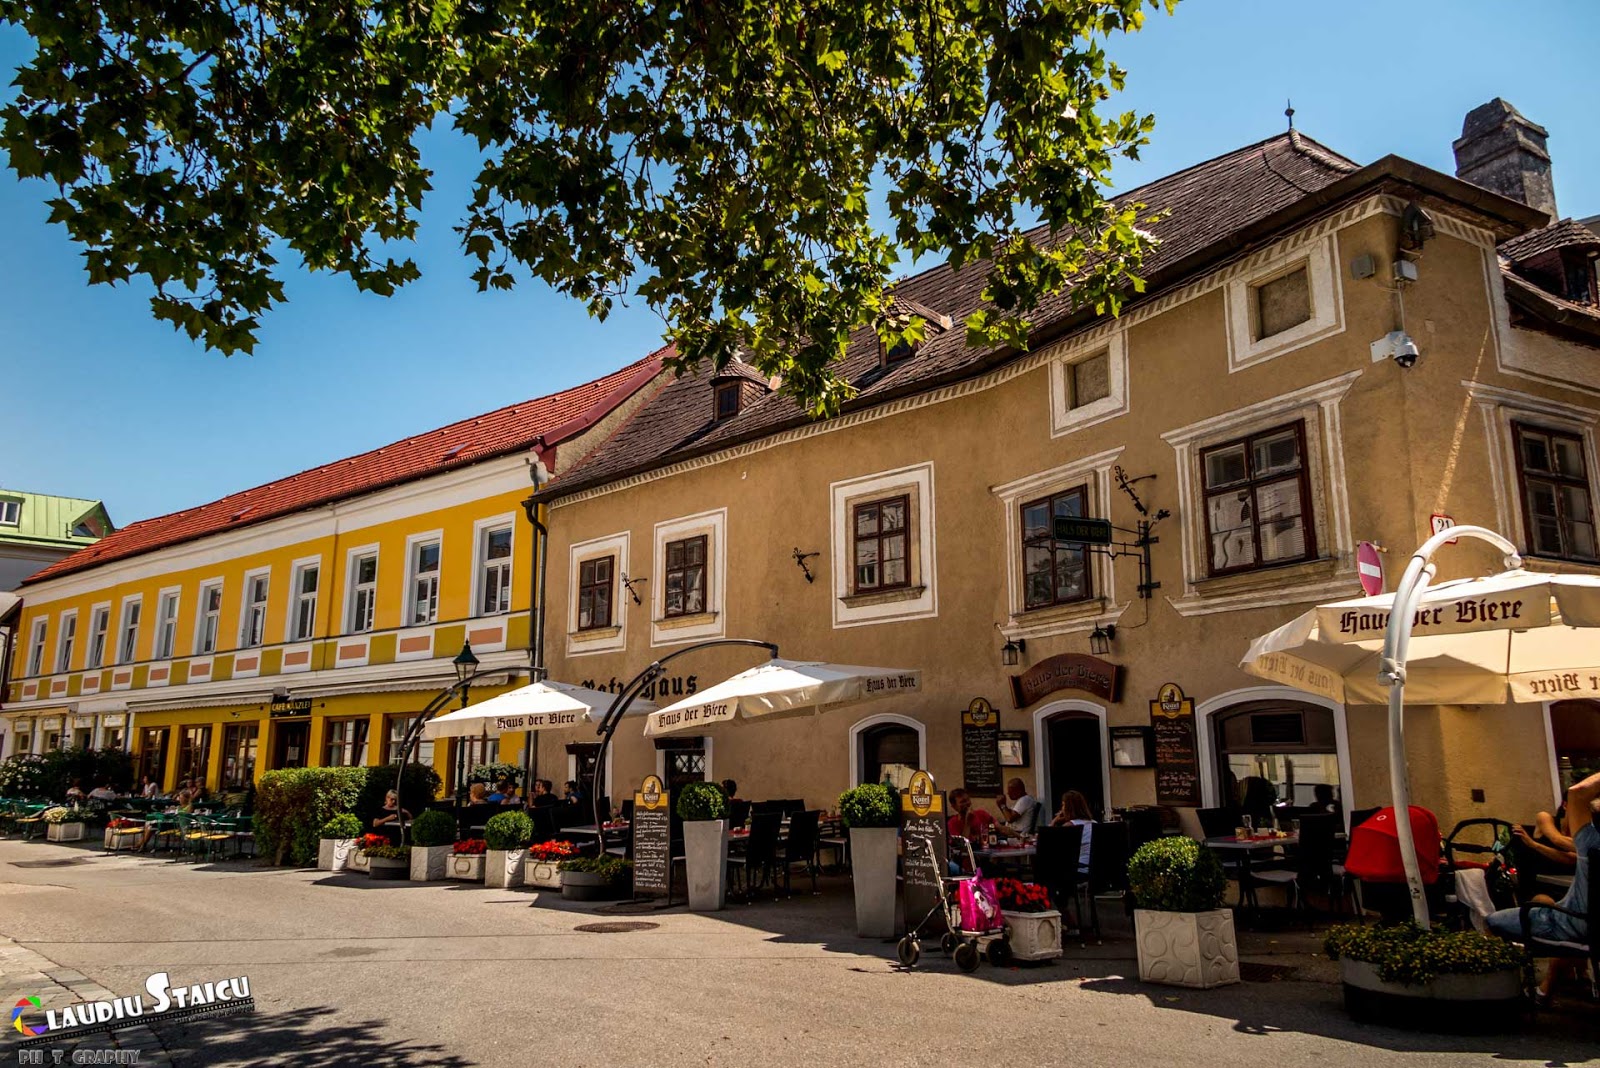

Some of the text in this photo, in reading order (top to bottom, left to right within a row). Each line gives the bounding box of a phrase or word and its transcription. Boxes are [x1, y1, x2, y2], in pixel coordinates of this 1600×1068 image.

[1455, 598, 1523, 623] Biere
[497, 712, 576, 729] Haus der Biere
[658, 712, 681, 728] Haus
[684, 709, 699, 721] der
[702, 704, 728, 718] Biere
